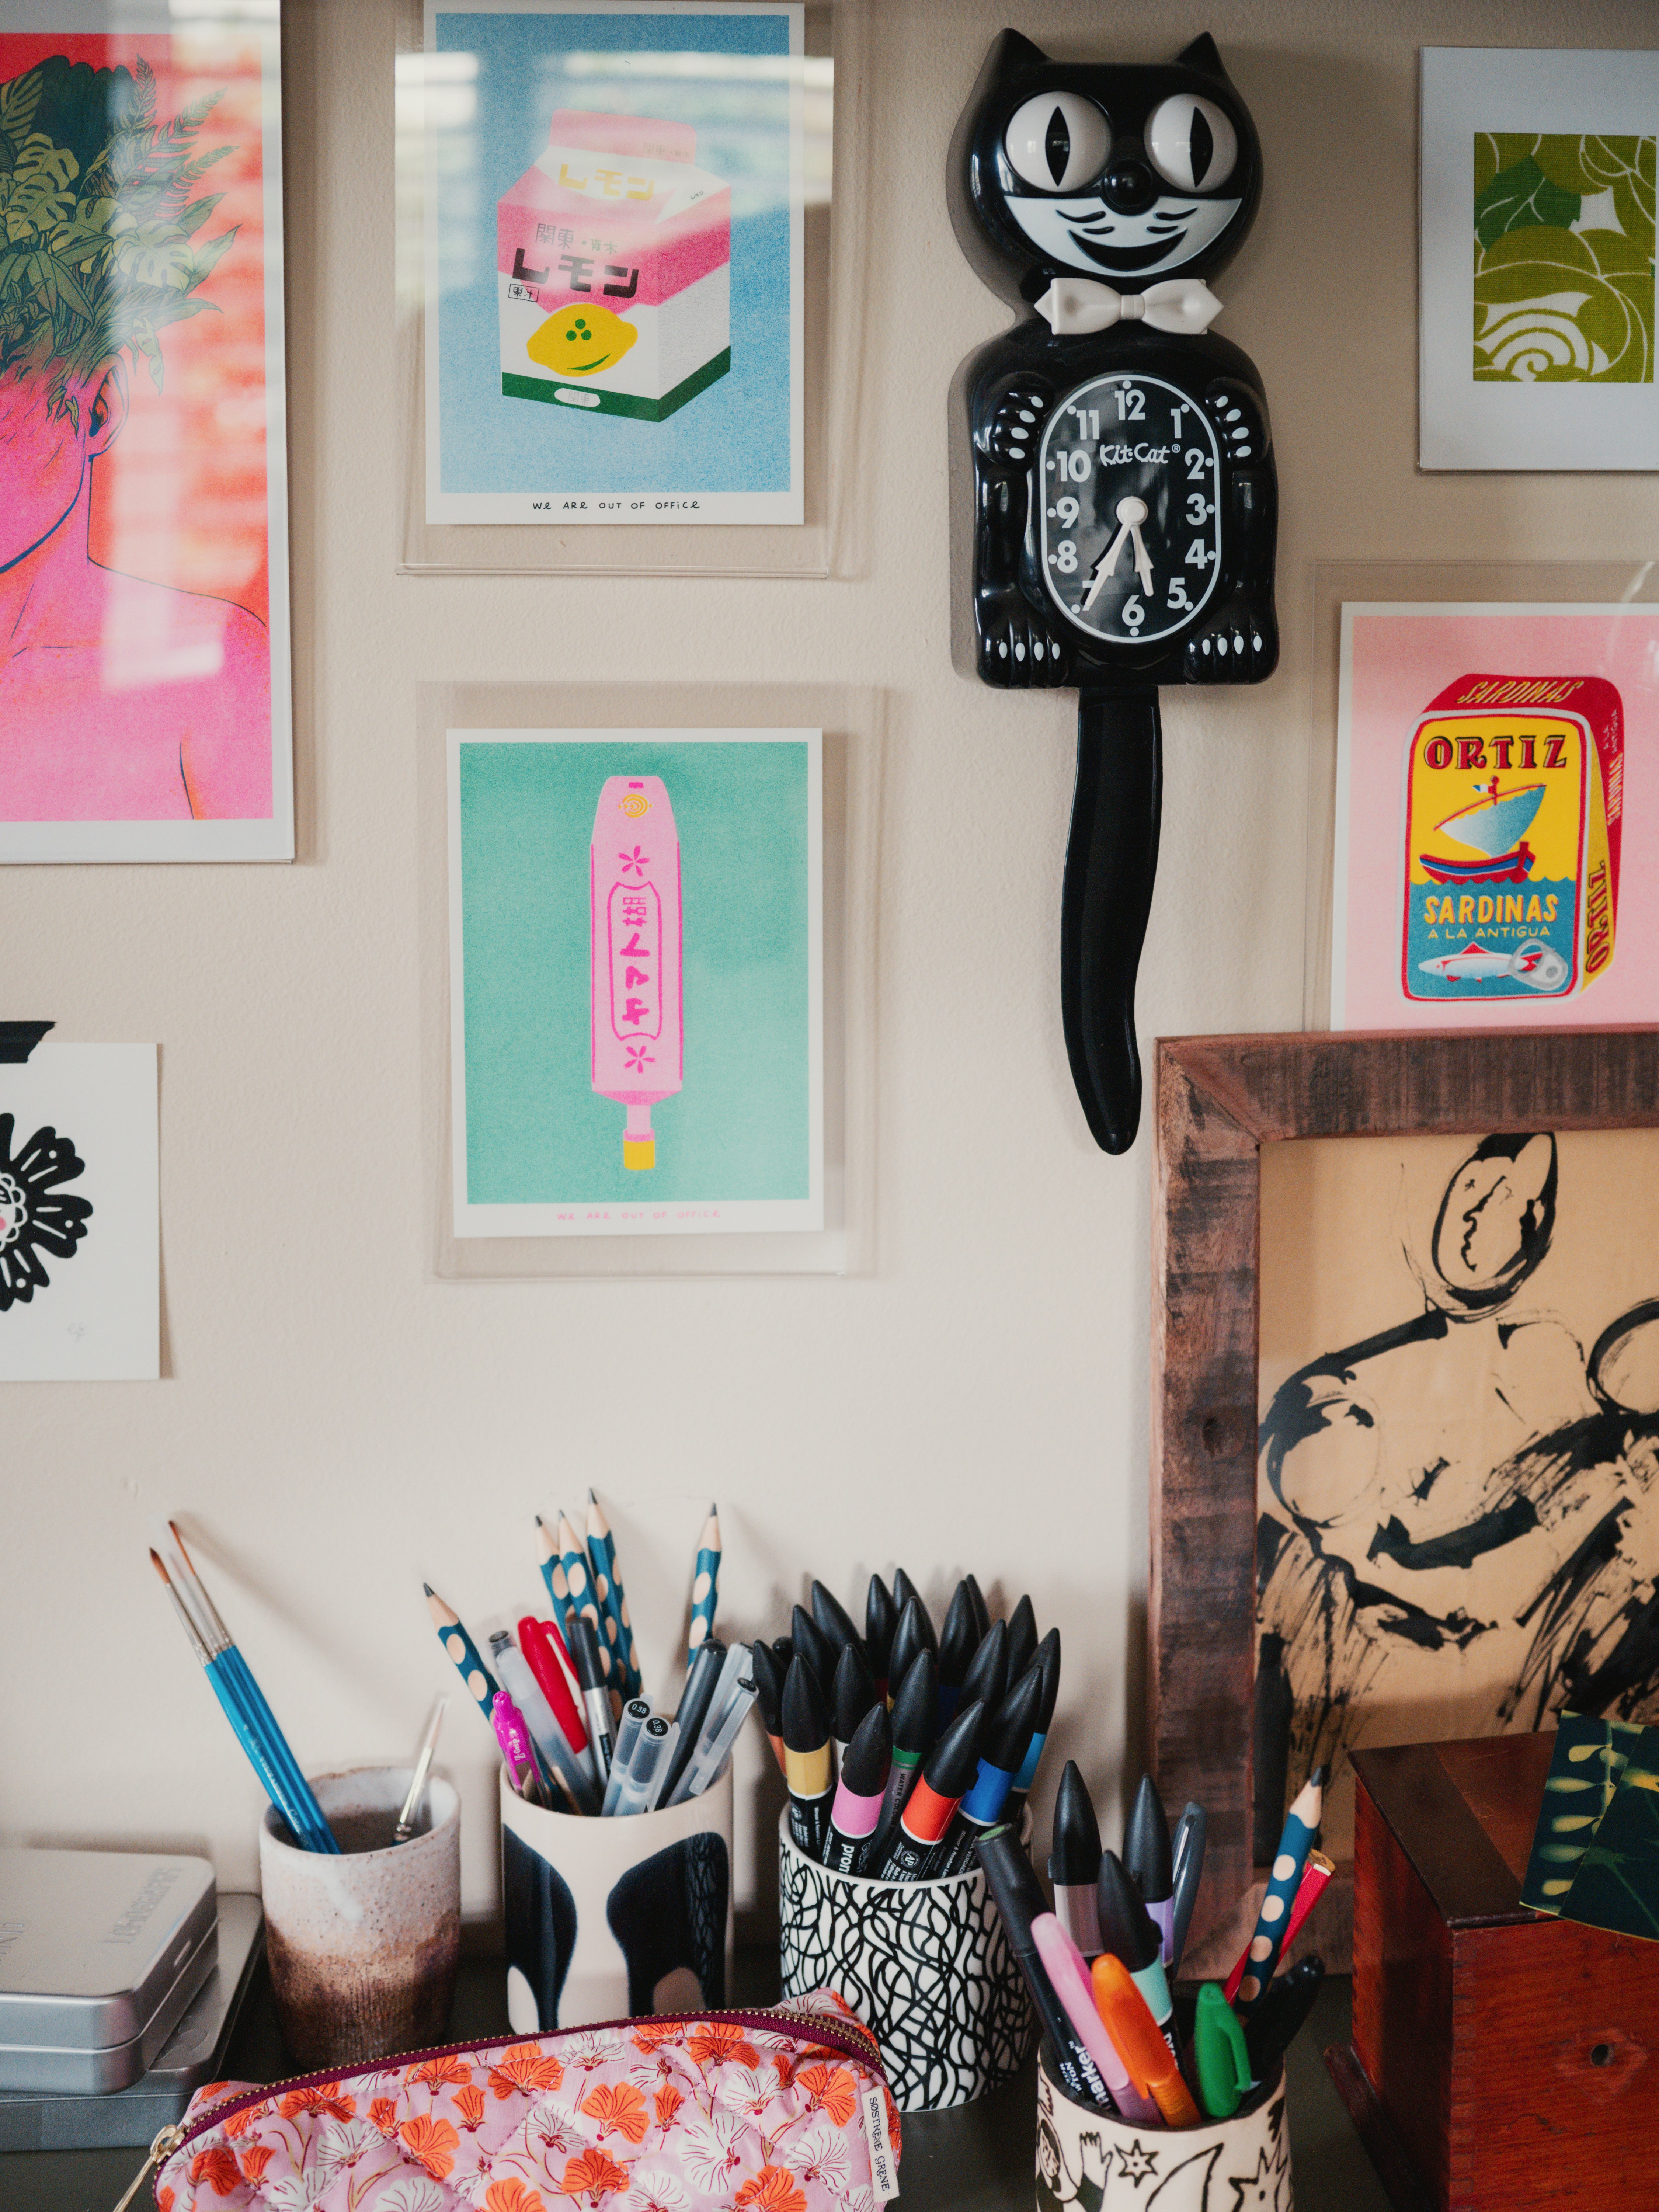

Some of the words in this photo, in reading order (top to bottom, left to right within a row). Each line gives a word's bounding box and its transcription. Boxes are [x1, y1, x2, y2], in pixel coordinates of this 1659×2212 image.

[558, 163, 655, 201] レモン
[512, 248, 639, 299] レモン
[1114, 389, 1146, 420] 12
[1076, 409, 1100, 440] 11
[1170, 408, 1182, 439] 1
[1057, 449, 1092, 483] 10
[1185, 448, 1205, 480] 2
[1056, 496, 1079, 529] 9
[1185, 493, 1207, 526] 3
[1057, 540, 1078, 573] 8
[1185, 539, 1208, 570] 4
[1167, 577, 1187, 610] 5
[1121, 595, 1145, 627] 6
[1454, 680, 1585, 704] SARDINAS
[1423, 734, 1567, 770] ORTIZ
[1423, 894, 1559, 925] SARDINAS
[1585, 860, 1610, 973] ORTIZ
[1428, 929, 1439, 939] A
[1445, 928, 1468, 939] LA
[1475, 926, 1550, 938] ANTIGUA
[632, 1704, 647, 1714] 0.38
[652, 1720, 662, 1733] 0.38
[897, 1773, 906, 1797] WATER
[957, 1830, 966, 1847] Winsor
[904, 1853, 915, 1866] AP
[946, 1851, 957, 1869] Newton
[869, 2097, 883, 2151] SØSTRENE
[875, 2156, 890, 2191] GRENE
